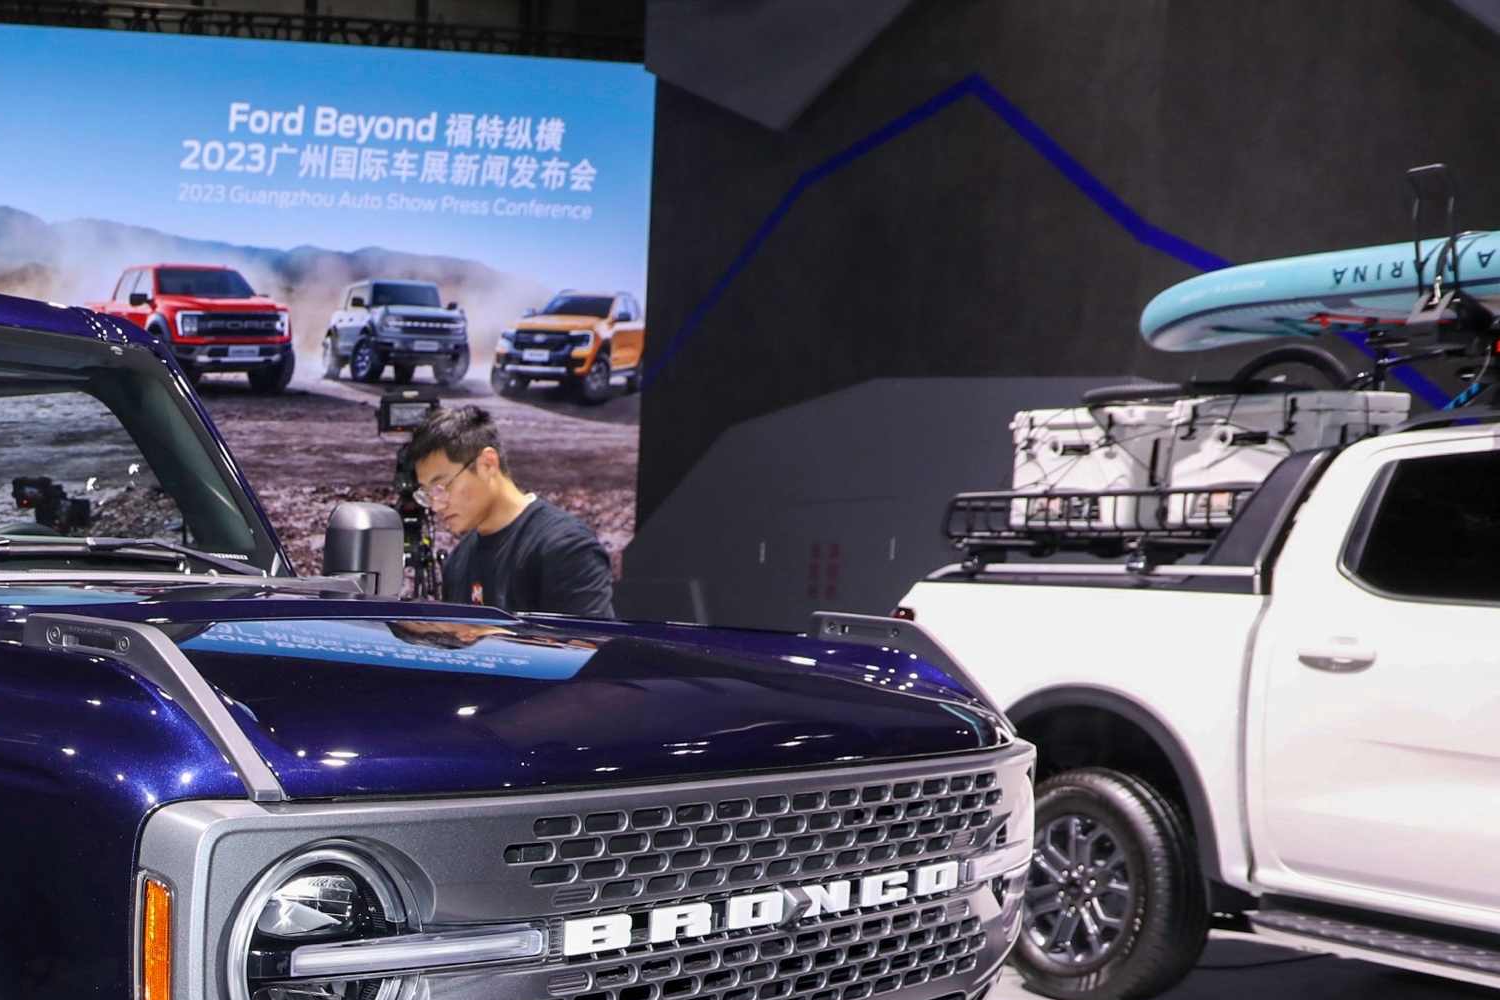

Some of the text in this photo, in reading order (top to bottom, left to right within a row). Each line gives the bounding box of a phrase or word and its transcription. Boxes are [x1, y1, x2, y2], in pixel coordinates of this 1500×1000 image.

[228, 102, 566, 153] Ford Beyond 福特纵横
[179, 139, 598, 192] 2023广州国际车展新闻发布会
[178, 182, 593, 220] 2023 Guangzhou Auto Show Press Conference
[563, 860, 960, 957] BRONCO
